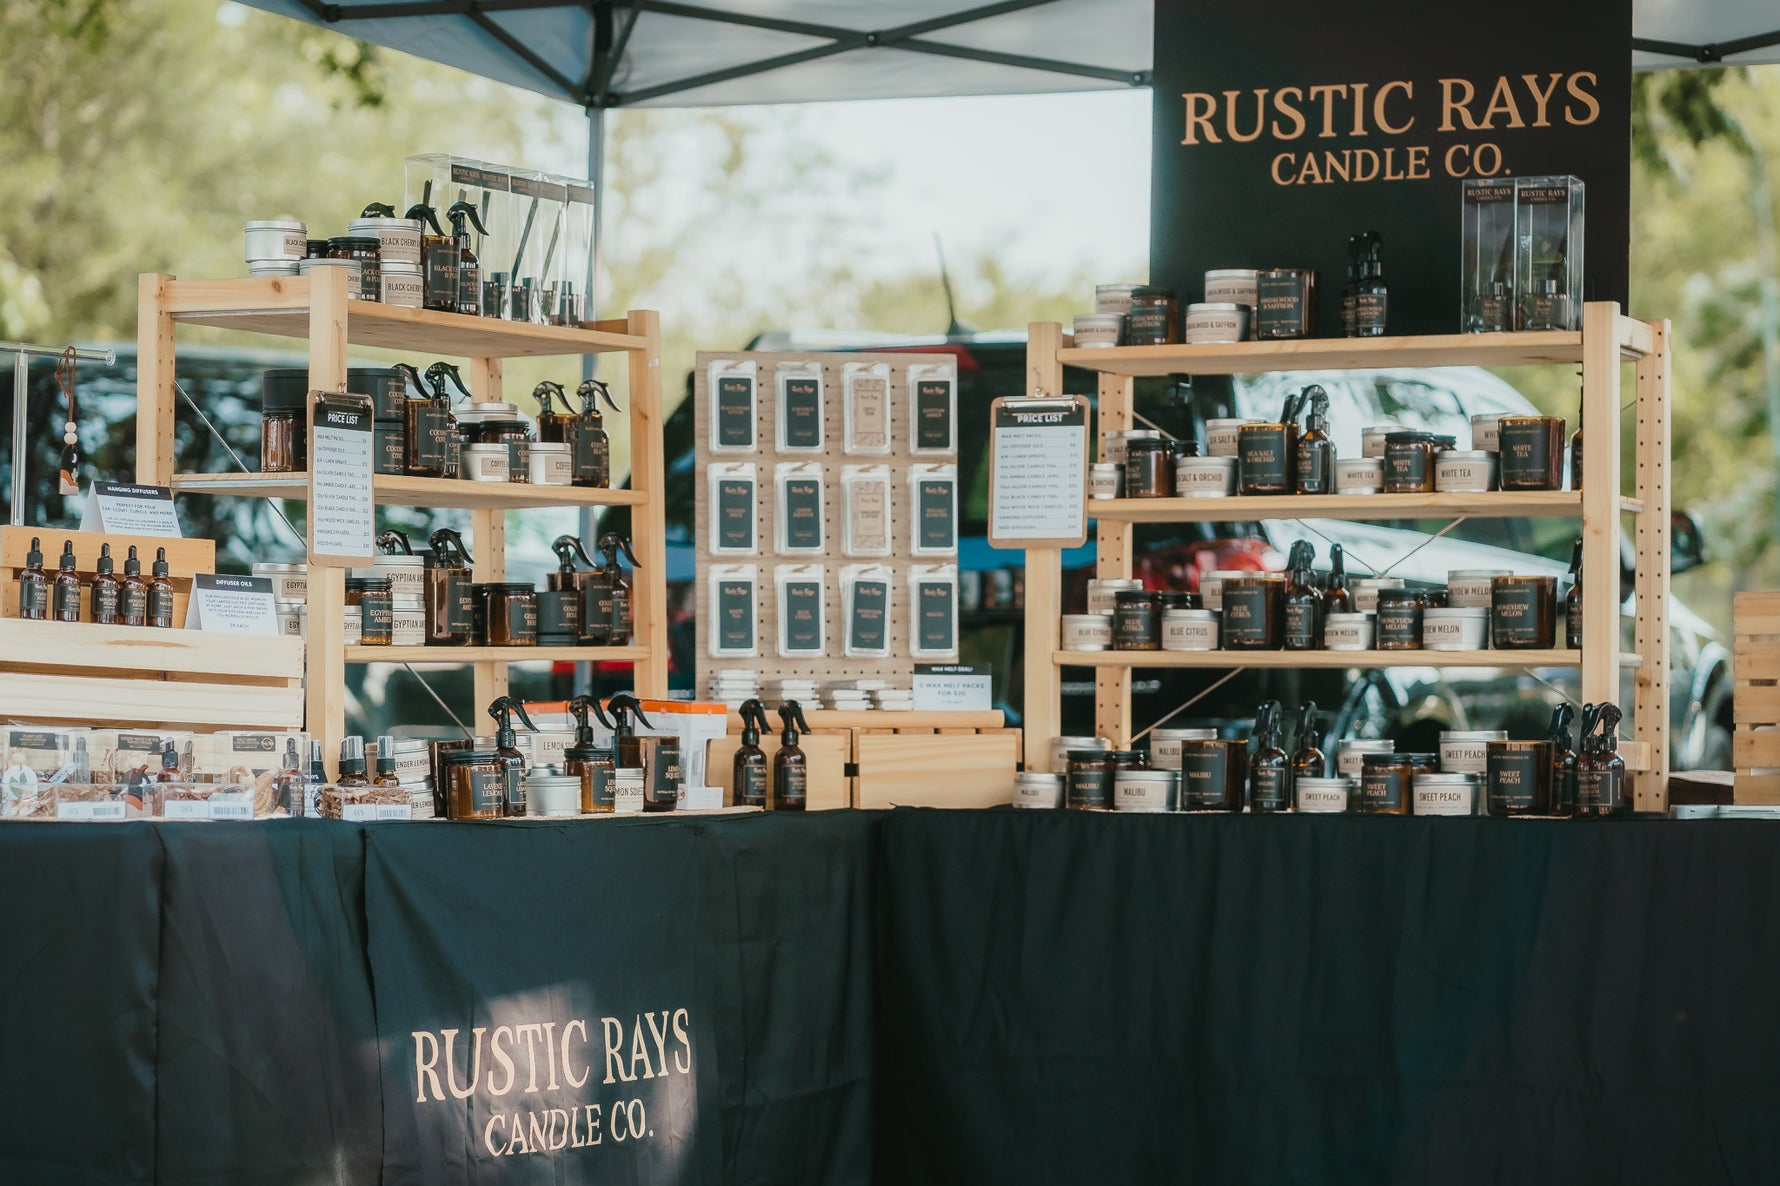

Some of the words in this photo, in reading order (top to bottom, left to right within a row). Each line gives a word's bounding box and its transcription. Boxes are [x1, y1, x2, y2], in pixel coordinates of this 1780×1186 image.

[1180, 80, 1415, 146] RUSTIC
[1437, 71, 1601, 132] RAYS
[1271, 145, 1431, 186] CANDLE
[1444, 143, 1512, 178] CO.
[1467, 189, 1492, 197] RUSTIC
[1494, 188, 1511, 196] RAYS
[1521, 190, 1546, 198] RUSTIC
[1548, 189, 1566, 197] RAYS
[381, 238, 399, 246] BLACK
[400, 238, 416, 247] CHERRY
[388, 283, 405, 291] BLACK
[328, 413, 345, 424] PRICE
[346, 415, 358, 424] LIST
[1017, 414, 1043, 423] PRICE
[1044, 414, 1063, 422] LIST
[1441, 469, 1458, 478] WHITE
[1459, 469, 1471, 478] TEA
[387, 573, 416, 583] EGYPTIAN
[394, 620, 418, 630] GYPTIAN
[1438, 624, 1460, 633] MELON
[1170, 628, 1184, 636] BLUE
[1186, 628, 1208, 636] CITRUS
[1445, 751, 1462, 759] SWEET
[1464, 750, 1486, 759] PEACH
[397, 760, 414, 768] ENDER
[1419, 793, 1438, 801] SWEET
[1439, 793, 1461, 801] PEACH
[411, 1019, 590, 1103] RUSTIC
[601, 1007, 691, 1085] RAYS
[484, 1103, 602, 1157] CANDLE
[610, 1098, 654, 1143] CO.
